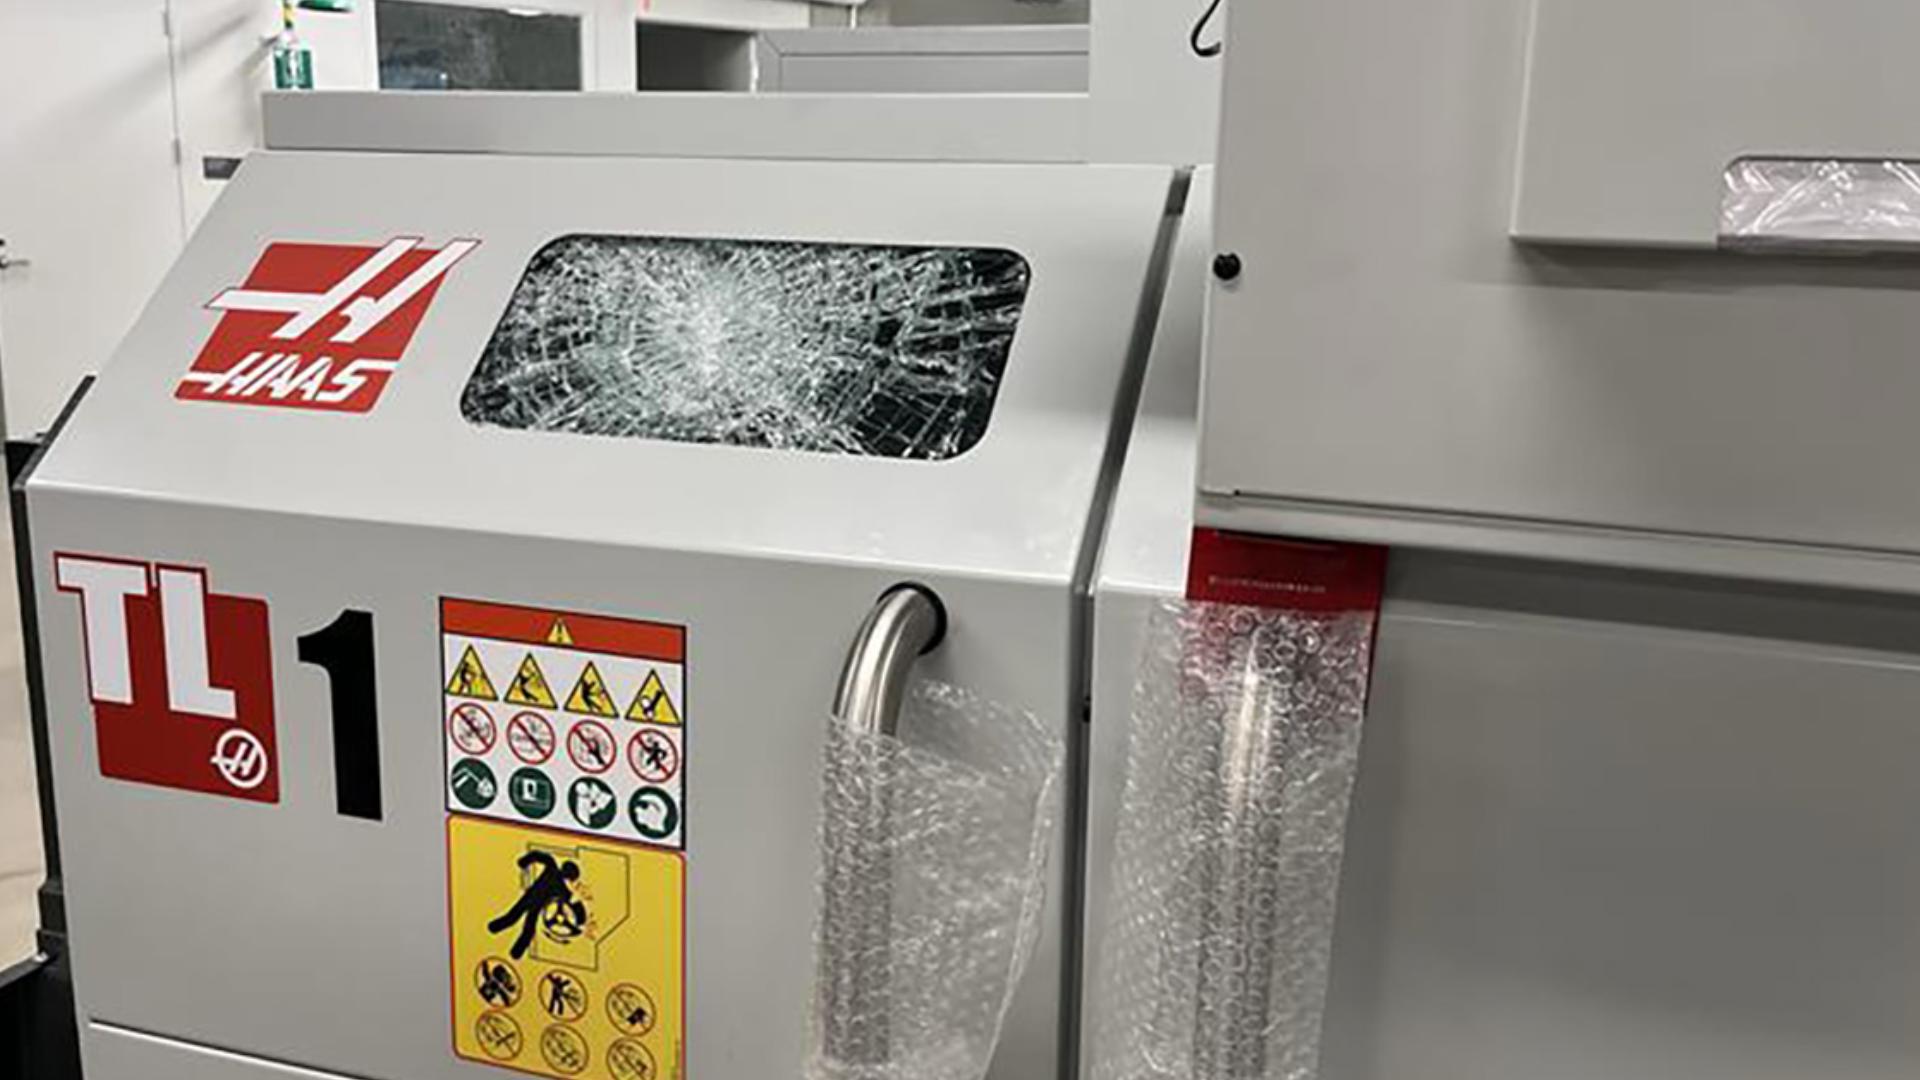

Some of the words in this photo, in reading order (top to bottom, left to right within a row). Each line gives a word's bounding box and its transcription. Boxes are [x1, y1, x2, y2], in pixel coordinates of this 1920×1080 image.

[182, 352, 399, 402] HAAS
[55, 553, 238, 720] TL
[297, 608, 383, 821] 1
